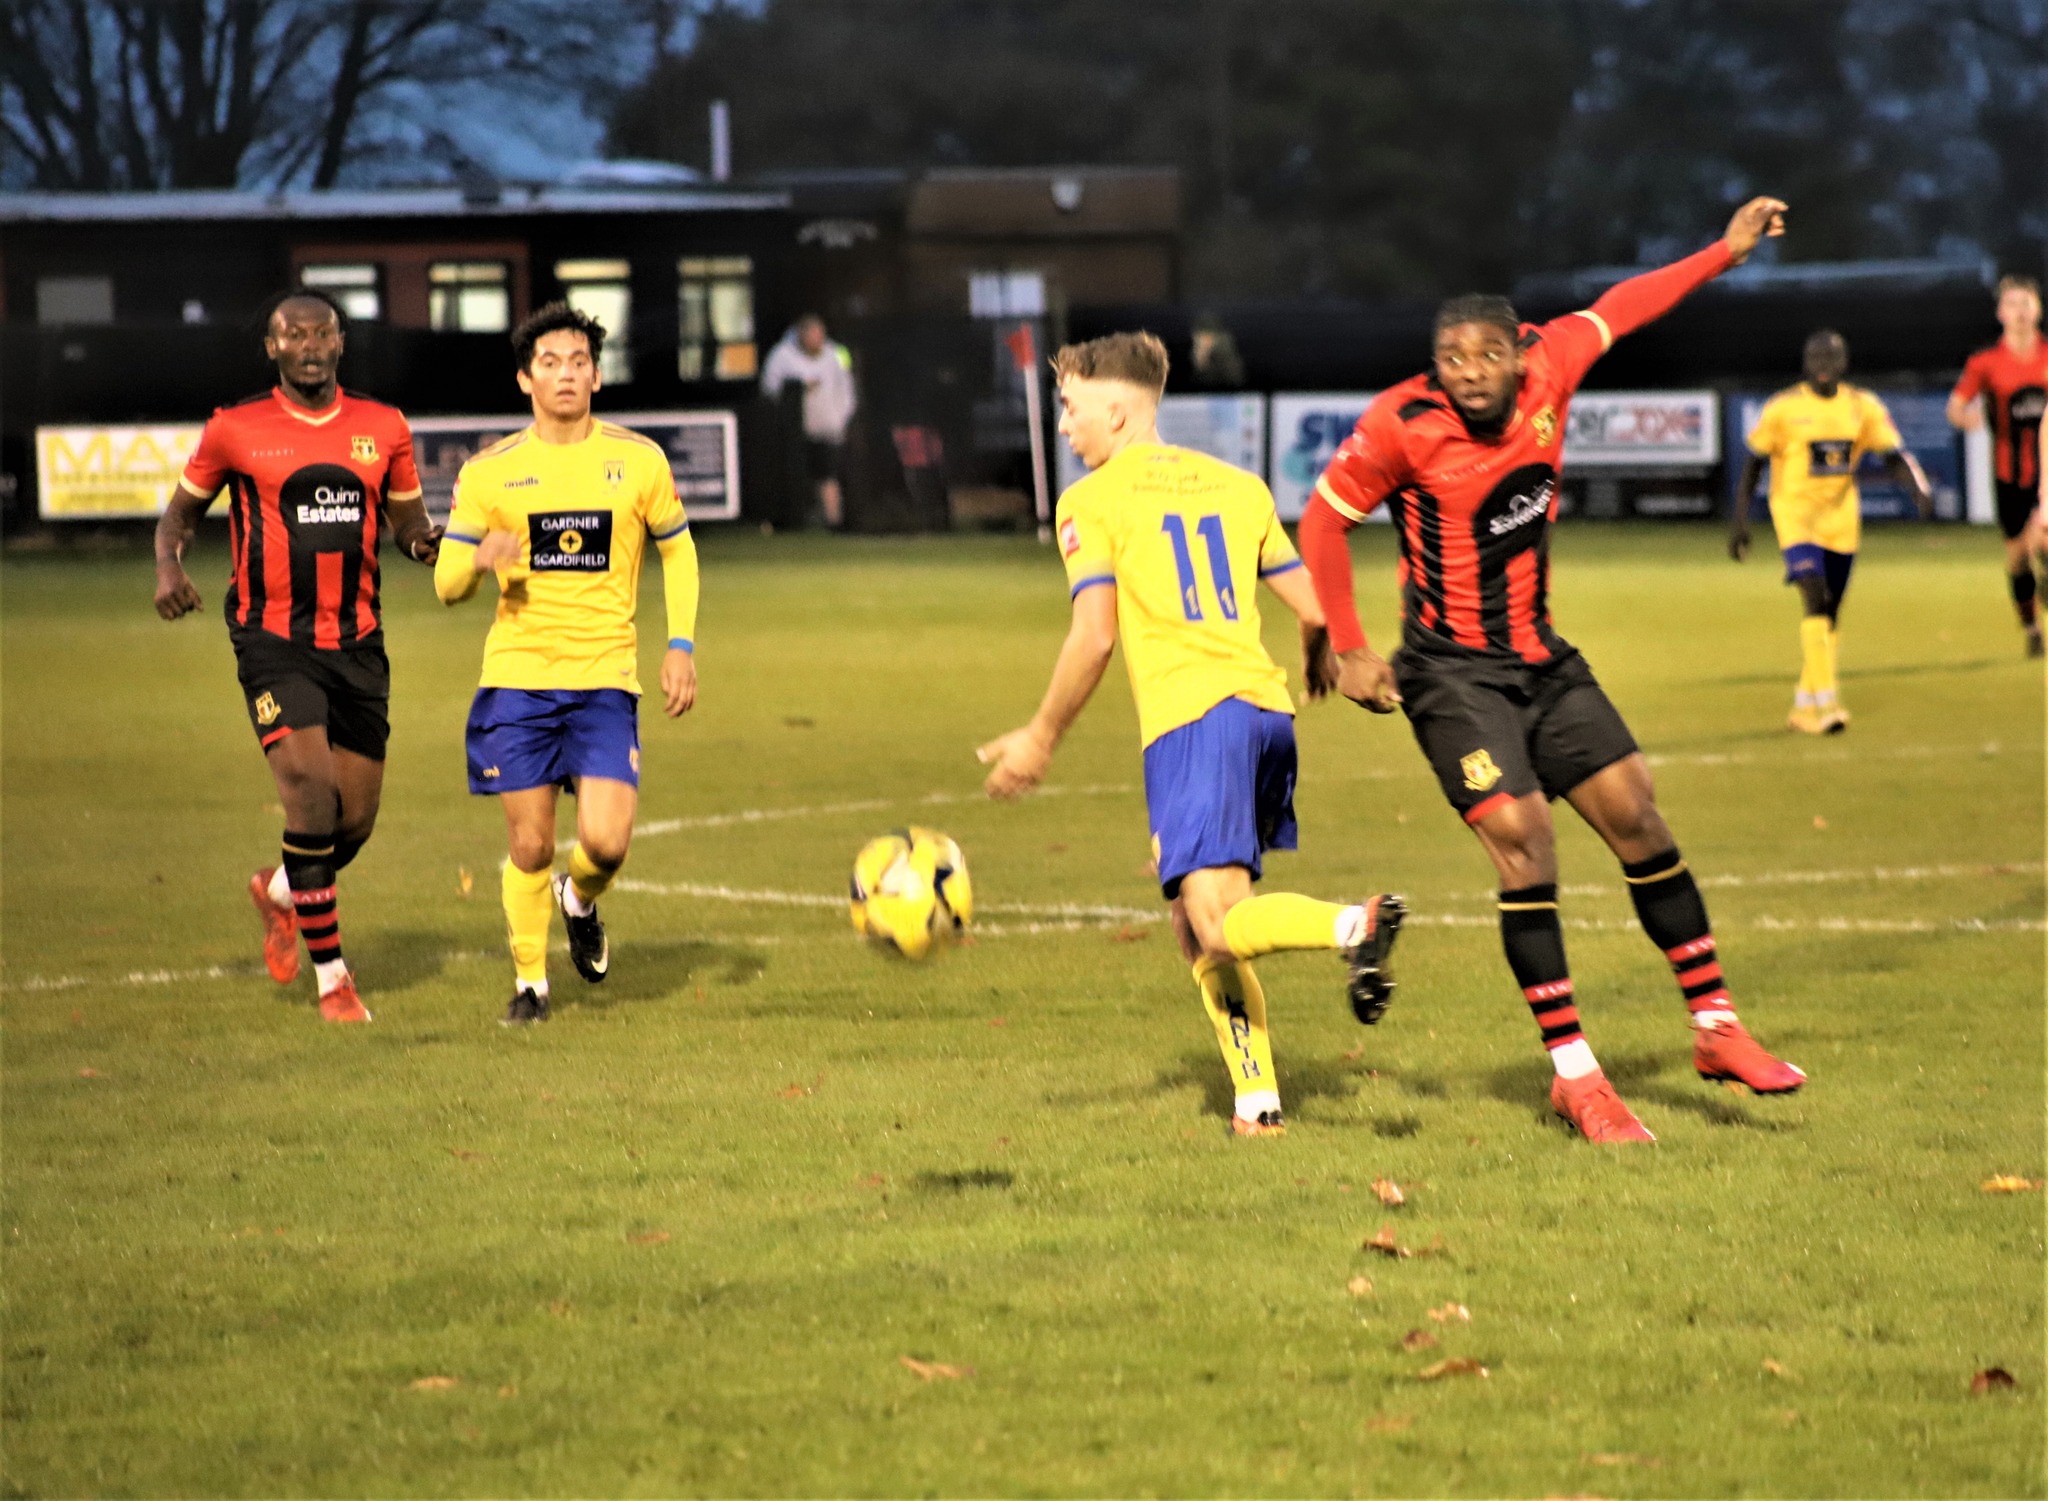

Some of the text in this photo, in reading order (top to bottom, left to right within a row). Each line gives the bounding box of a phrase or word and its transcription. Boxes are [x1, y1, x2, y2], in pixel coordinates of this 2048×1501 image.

[315, 486, 360, 505] Quinn
[297, 505, 361, 524] Estates
[541, 516, 600, 531] GARDNER
[533, 553, 606, 567] SCARDIFIELD
[1160, 513, 1239, 621] 11
